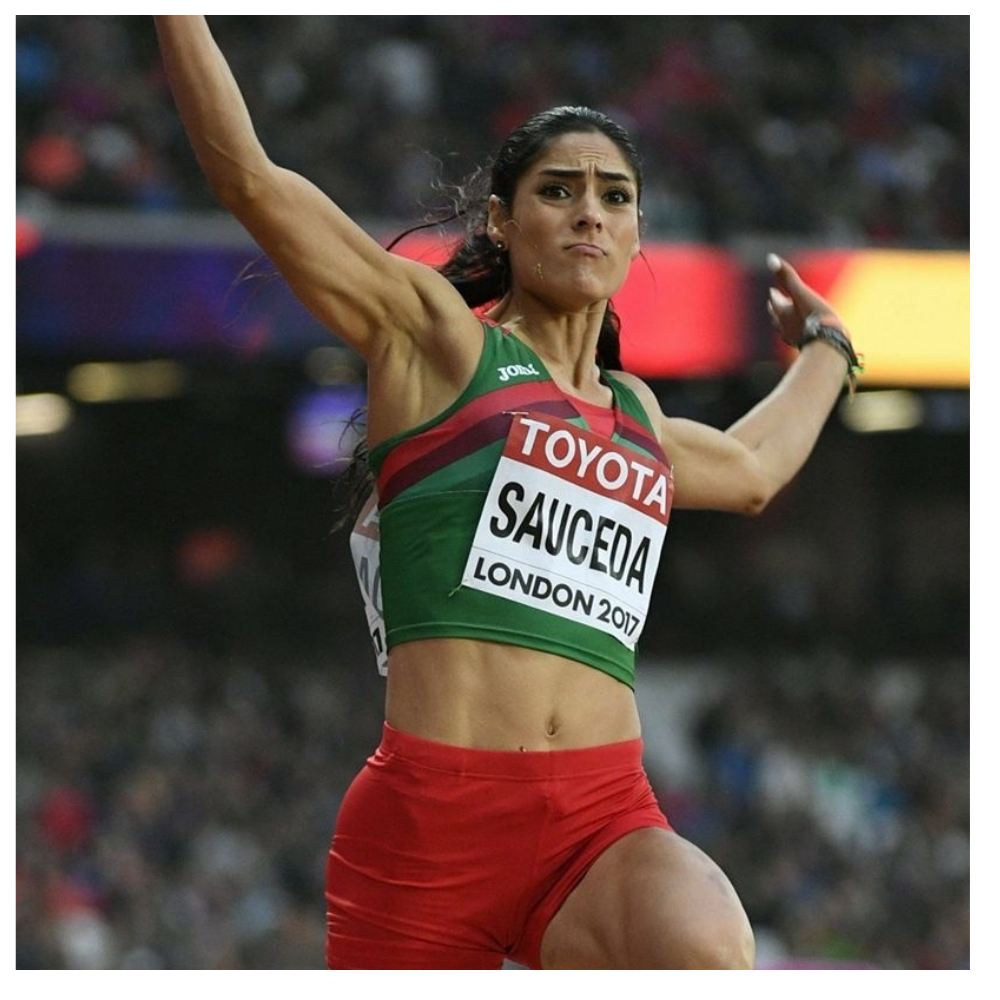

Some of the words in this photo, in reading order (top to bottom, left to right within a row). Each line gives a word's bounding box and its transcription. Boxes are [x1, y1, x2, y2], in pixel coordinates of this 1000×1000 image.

[520, 417, 670, 516] TOYOTA
[489, 481, 652, 594] SAUCEDA
[473, 556, 595, 616] LONDON
[596, 598, 641, 637] 2017
